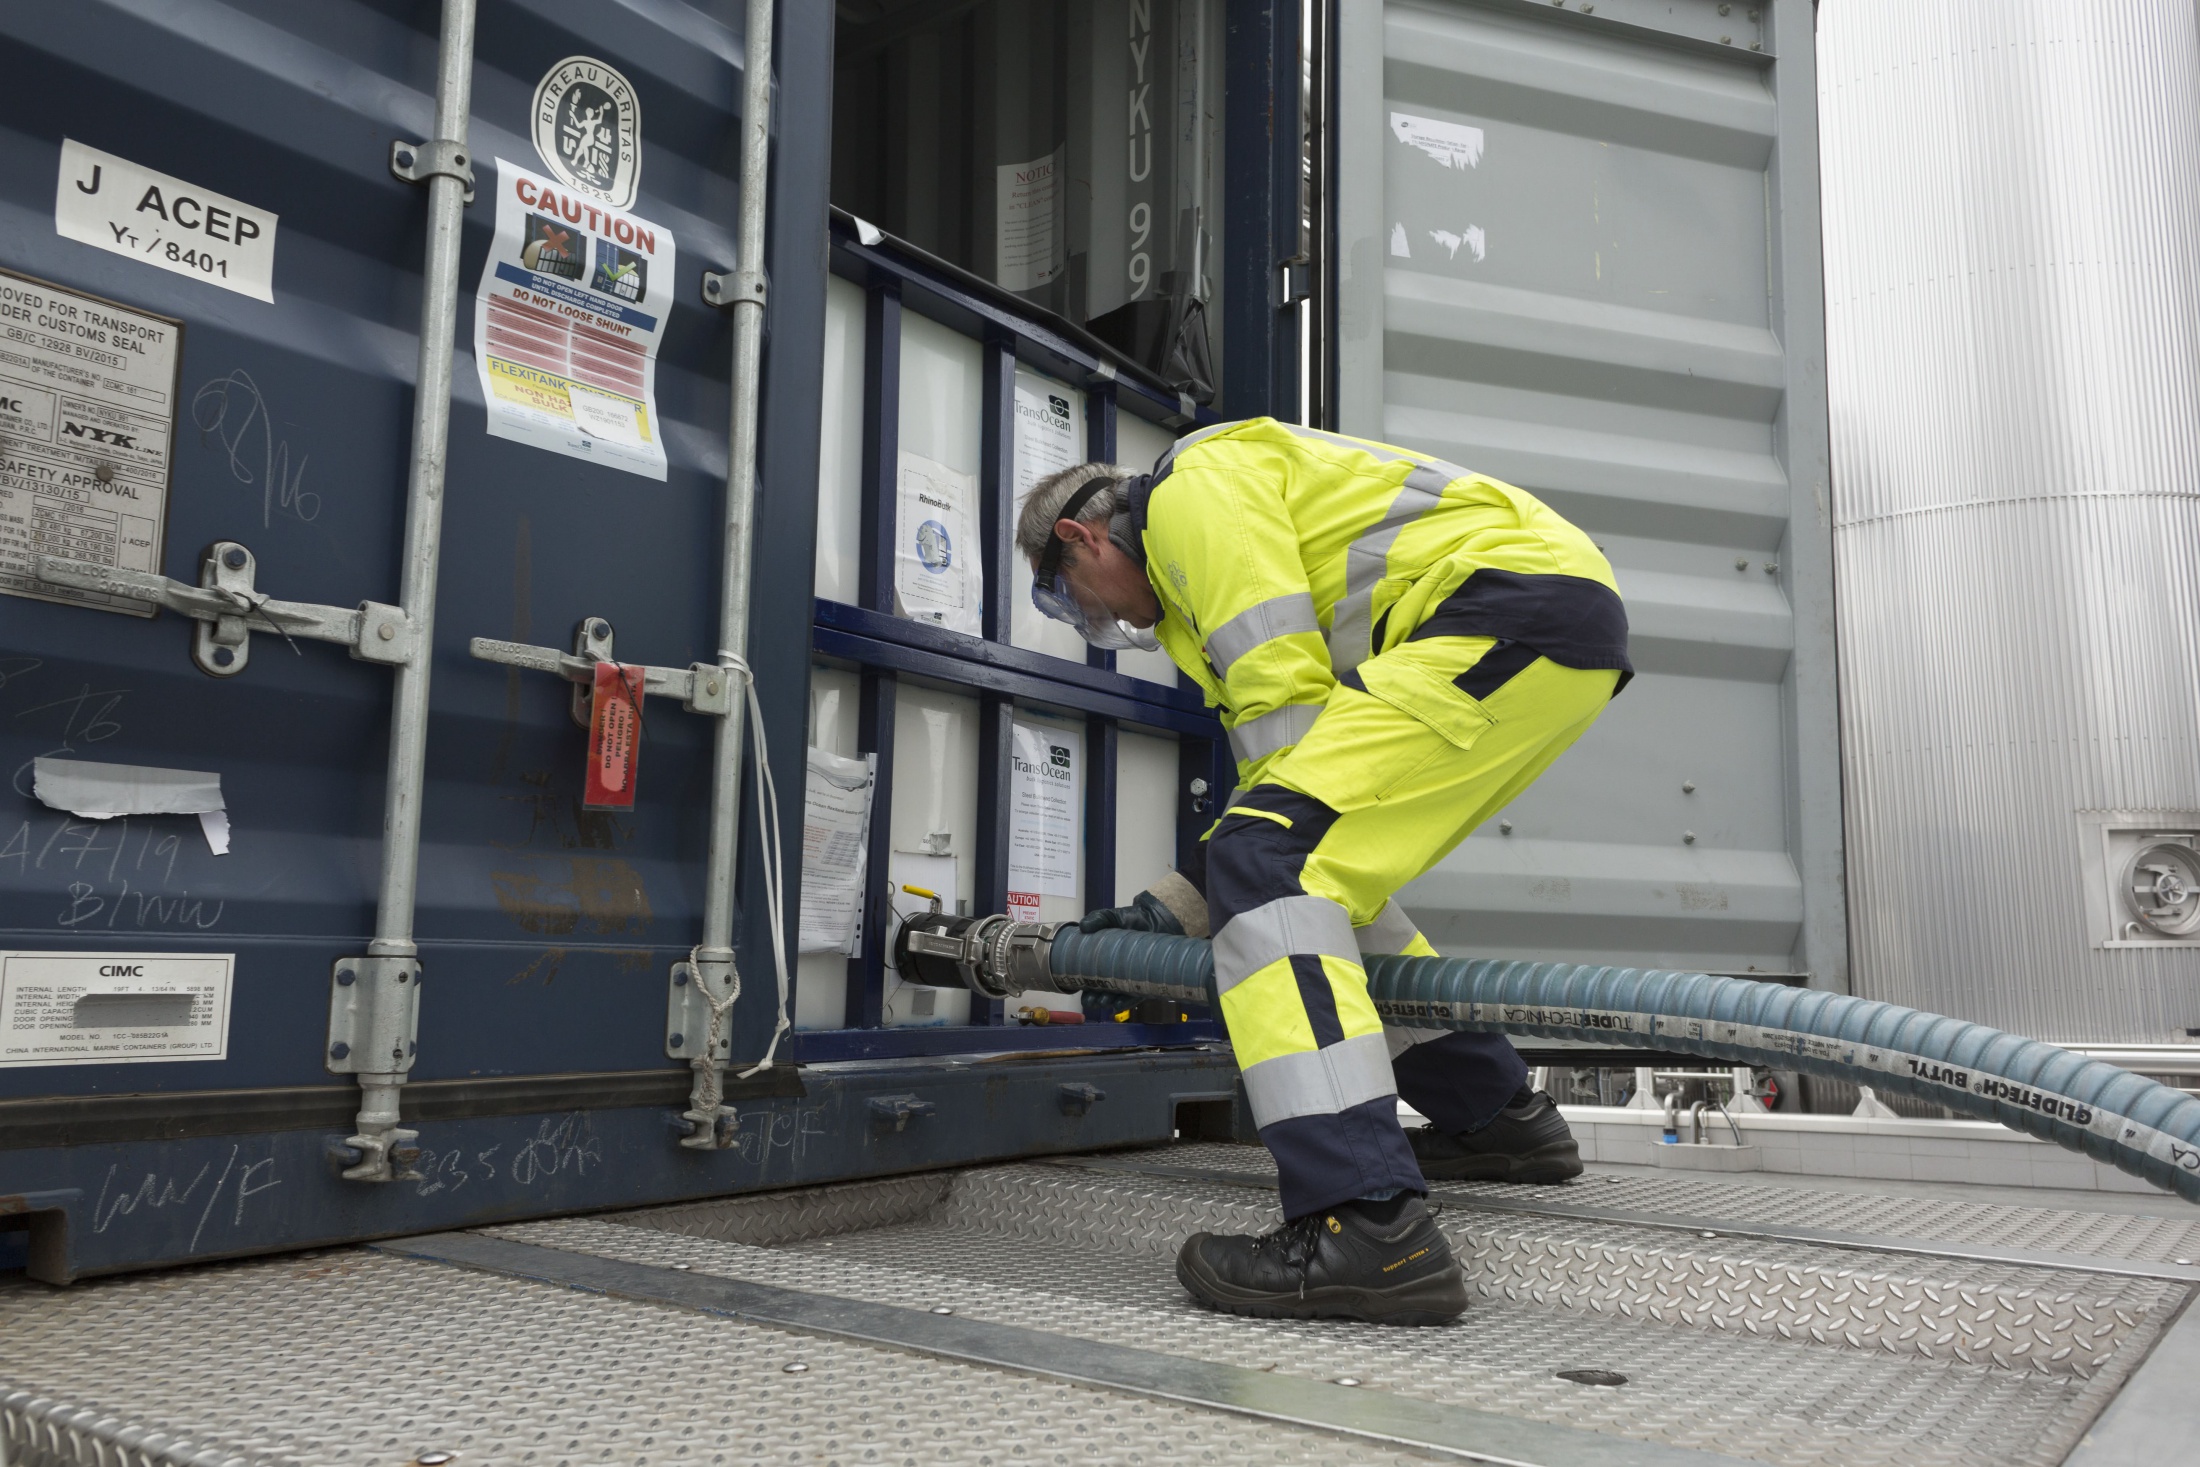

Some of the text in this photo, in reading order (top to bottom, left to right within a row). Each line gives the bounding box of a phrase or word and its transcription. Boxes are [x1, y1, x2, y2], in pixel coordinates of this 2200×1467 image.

[542, 66, 632, 163] BUREAU VERITAS
[571, 177, 614, 203] 1828
[76, 165, 260, 247] J ACEP
[516, 178, 655, 255] CAUTION
[531, 283, 621, 319] UNTIL DISCHARGE COMPLETED
[532, 275, 624, 312] DO NOT OPEN LEFT HAND DOOR
[0, 286, 165, 344] OVED FOR TRANSPORT
[512, 288, 632, 337] DO NOT LOOSE SHUNT
[0, 303, 146, 355] DER CUSTOMS SEAL
[7, 328, 119, 366] GB/C 12928 BV/2015
[58, 373, 95, 388] CONTAINER
[492, 361, 567, 391] FLEXITANK
[0, 396, 23, 413] MC
[514, 385, 545, 400] NON
[531, 397, 569, 413] BULK
[1014, 399, 1071, 433] TransOcean
[62, 421, 137, 449] NYK
[26, 443, 70, 460] TREATMENT
[0, 458, 140, 500] SAFETY APPROVAL
[605, 753, 611, 769] DO
[609, 702, 617, 729] OPEN
[615, 715, 625, 758] PELIGRO
[1012, 756, 1071, 782] TransOcean
[1007, 893, 1039, 906] AUTION
[99, 965, 144, 977] CIMC
[1503, 1008, 1633, 1032] TUDERTECHNICA
[93, 1044, 120, 1052] MARINE
[123, 1043, 167, 1051] CONTAINERS
[170, 1042, 198, 1050] (GROUP)
[1908, 1059, 1968, 1088] BUTYL
